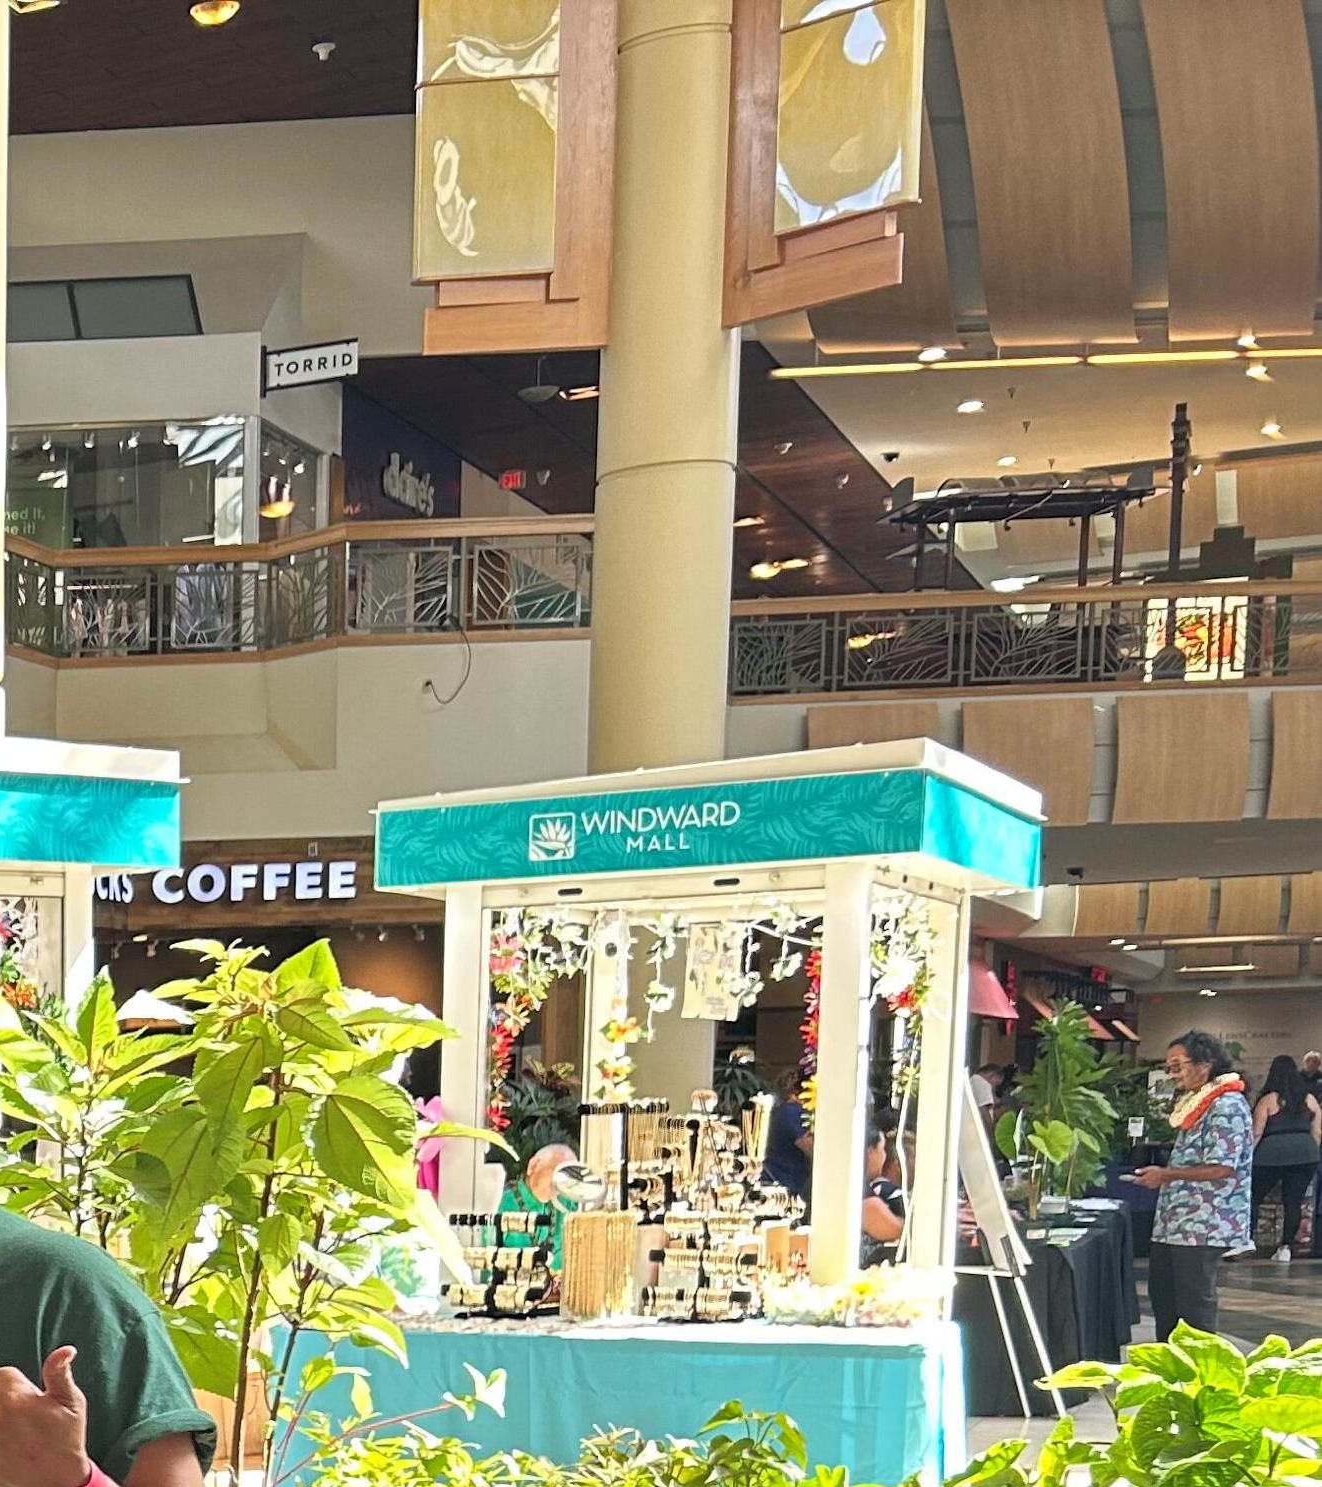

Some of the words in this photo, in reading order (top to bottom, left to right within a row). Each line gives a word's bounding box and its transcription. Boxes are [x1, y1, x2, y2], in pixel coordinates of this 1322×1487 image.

[275, 353, 352, 376] TORRID
[581, 801, 741, 836] WINDWARD
[626, 832, 690, 853] MALL
[152, 861, 357, 904] COFFEE
